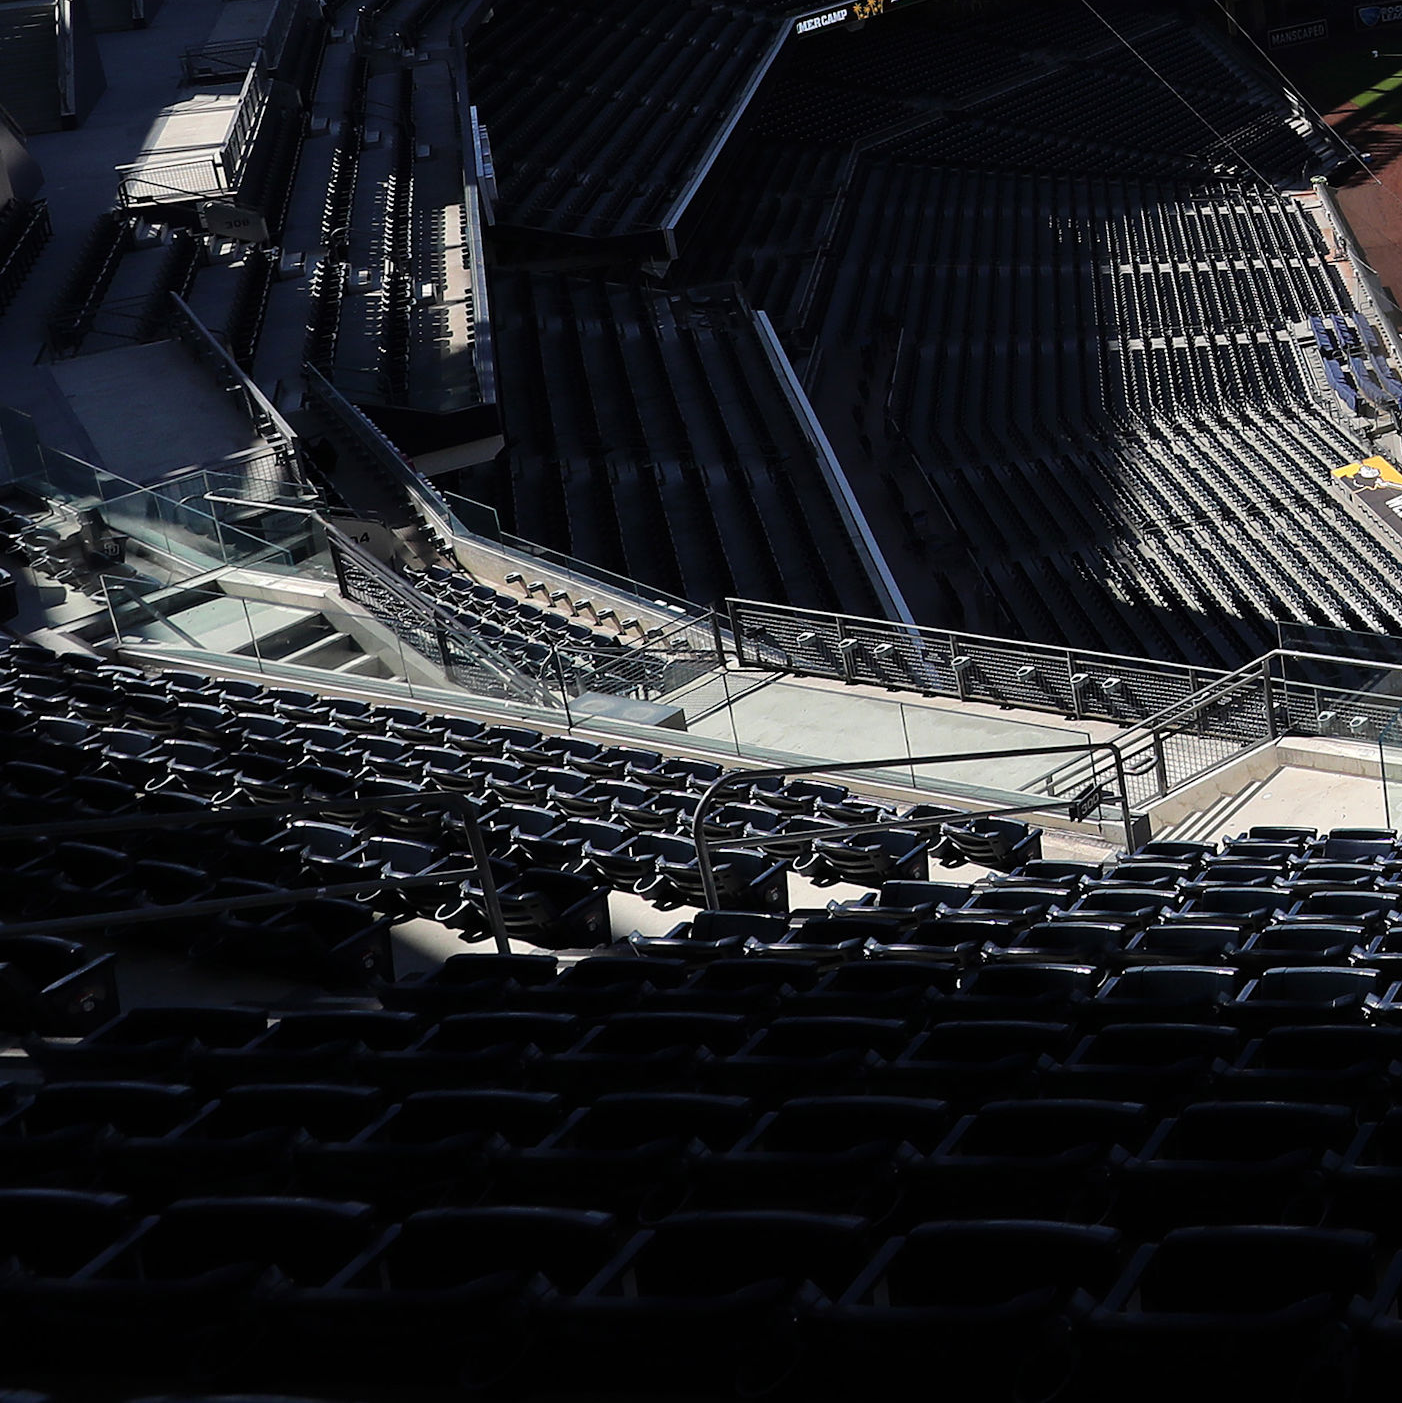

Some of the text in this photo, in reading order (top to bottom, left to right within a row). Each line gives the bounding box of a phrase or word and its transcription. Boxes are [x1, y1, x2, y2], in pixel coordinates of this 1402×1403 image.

[820, 8, 849, 29] CAMP
[1270, 25, 1325, 46] MANSCAPED
[1080, 792, 1100, 815] 300
